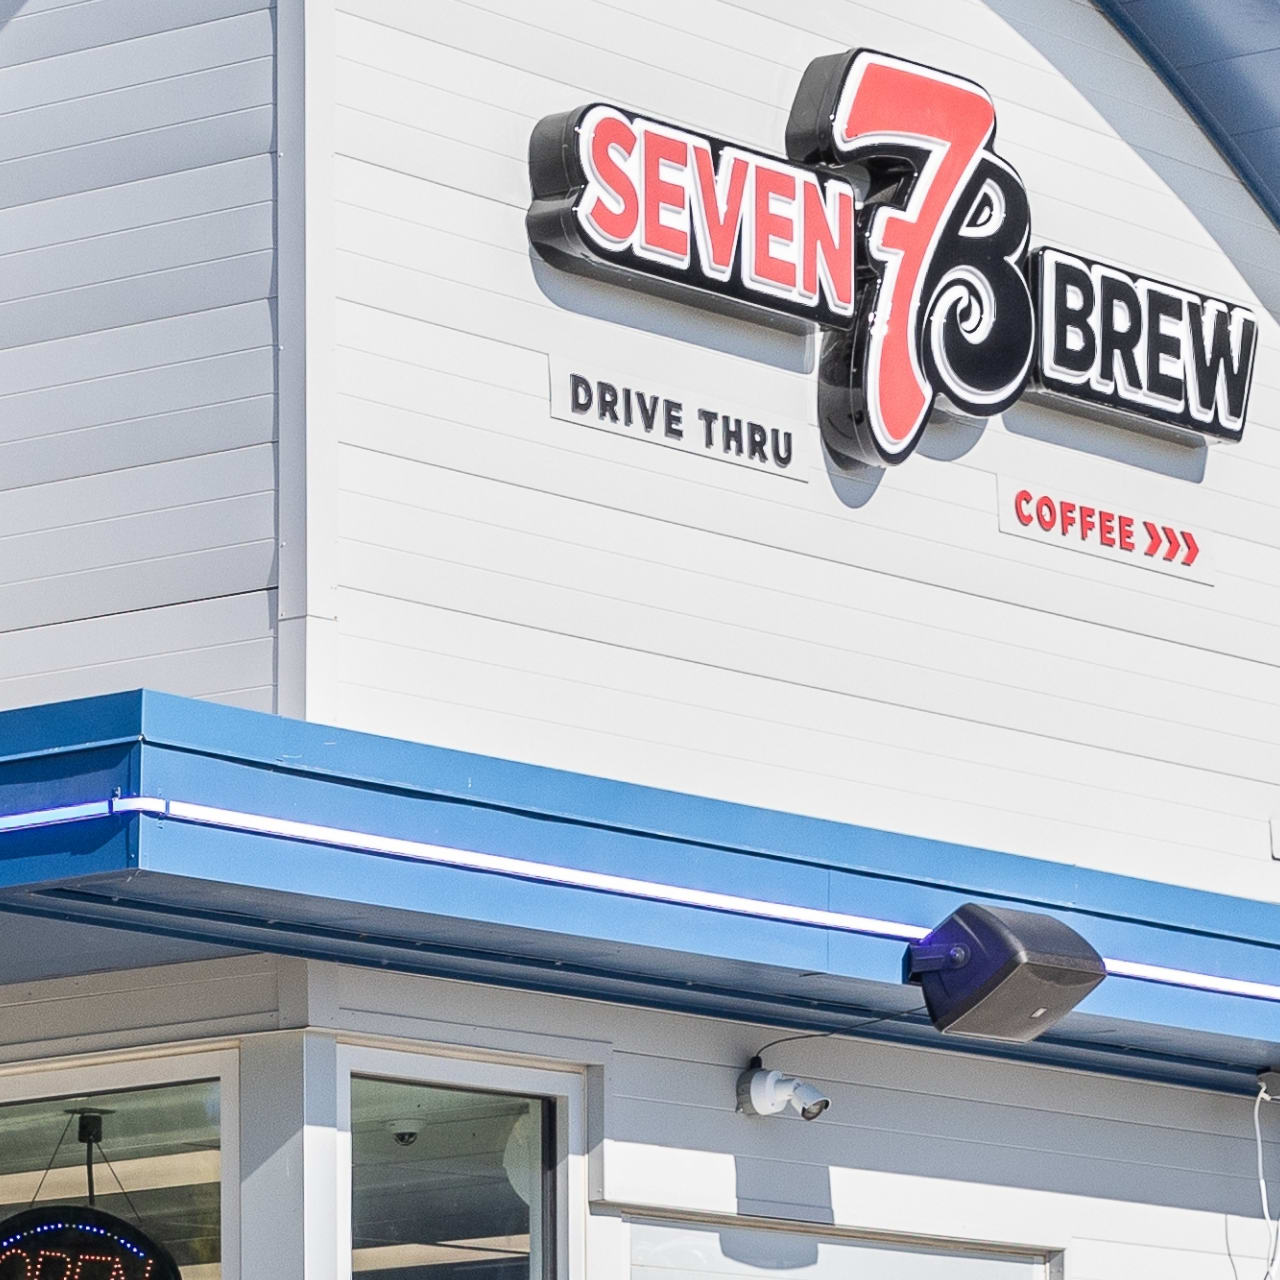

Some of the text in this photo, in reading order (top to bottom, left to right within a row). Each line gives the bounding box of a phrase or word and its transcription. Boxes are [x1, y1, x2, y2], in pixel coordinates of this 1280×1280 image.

[586, 113, 854, 308] SEVEN
[1053, 251, 1260, 422] BREW
[569, 373, 793, 467] DRIVE THRU
[1014, 489, 1136, 552] COFFEE
